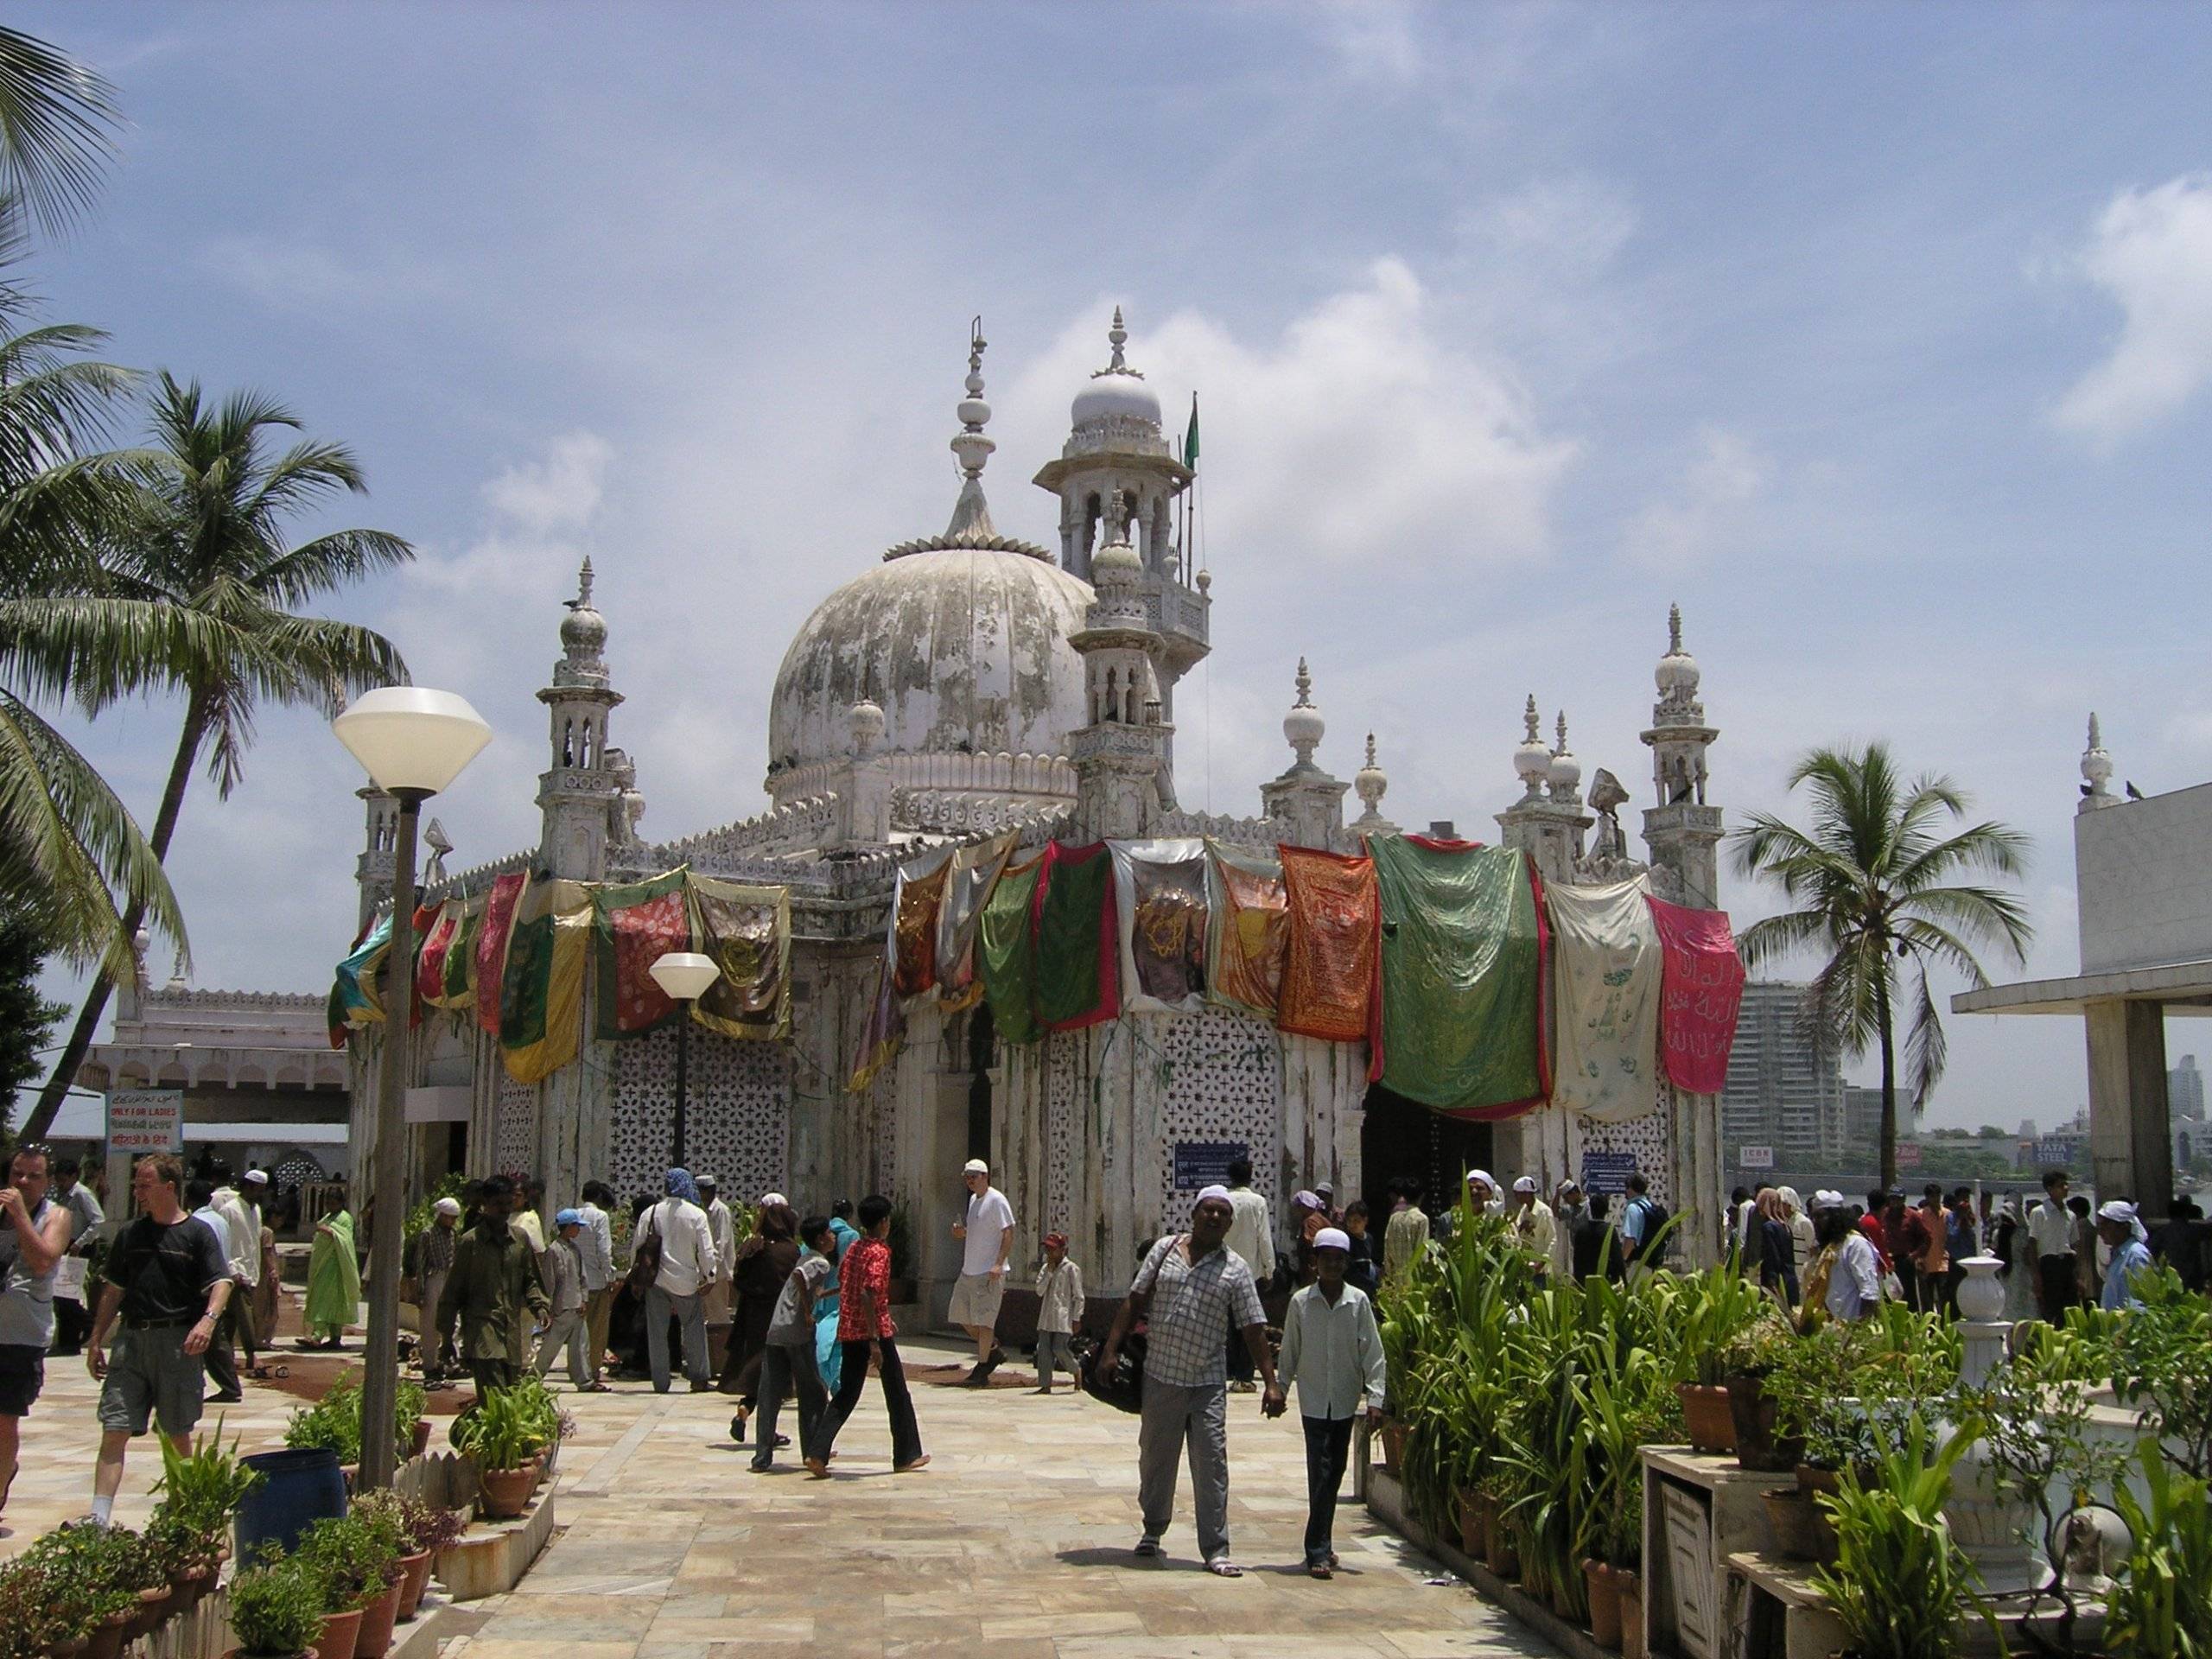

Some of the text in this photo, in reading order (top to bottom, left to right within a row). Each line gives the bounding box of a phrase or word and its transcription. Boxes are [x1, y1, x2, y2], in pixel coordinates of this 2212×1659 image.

[111, 1108, 176, 1116] ONLY FOR LADIES
[2037, 1142, 2067, 1153] TATA
[2037, 1153, 2067, 1162] STEEL
